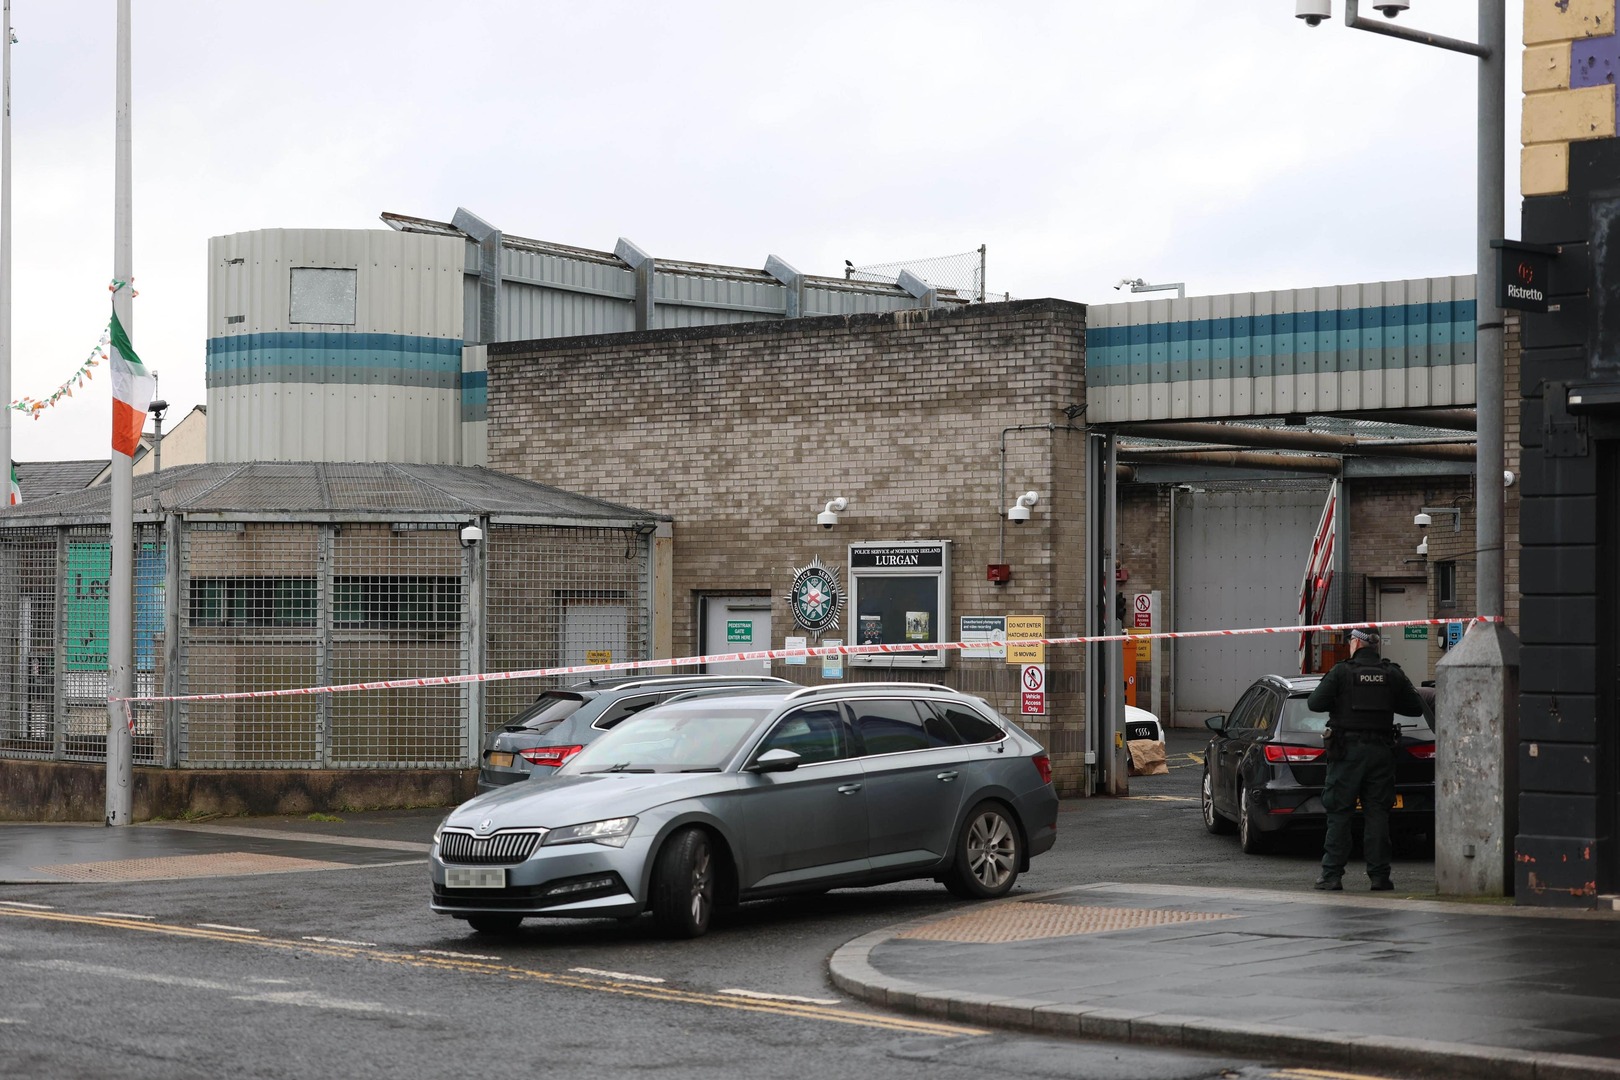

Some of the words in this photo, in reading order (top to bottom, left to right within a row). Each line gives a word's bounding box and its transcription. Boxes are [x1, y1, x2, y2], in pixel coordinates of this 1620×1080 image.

[1508, 284, 1543, 301] Ristretto
[876, 555, 918, 566] LURGAN
[794, 570, 811, 593] POLICE
[818, 570, 836, 595] SERVICE
[794, 602, 812, 626] NORTHERN
[819, 606, 835, 626] IRELAND
